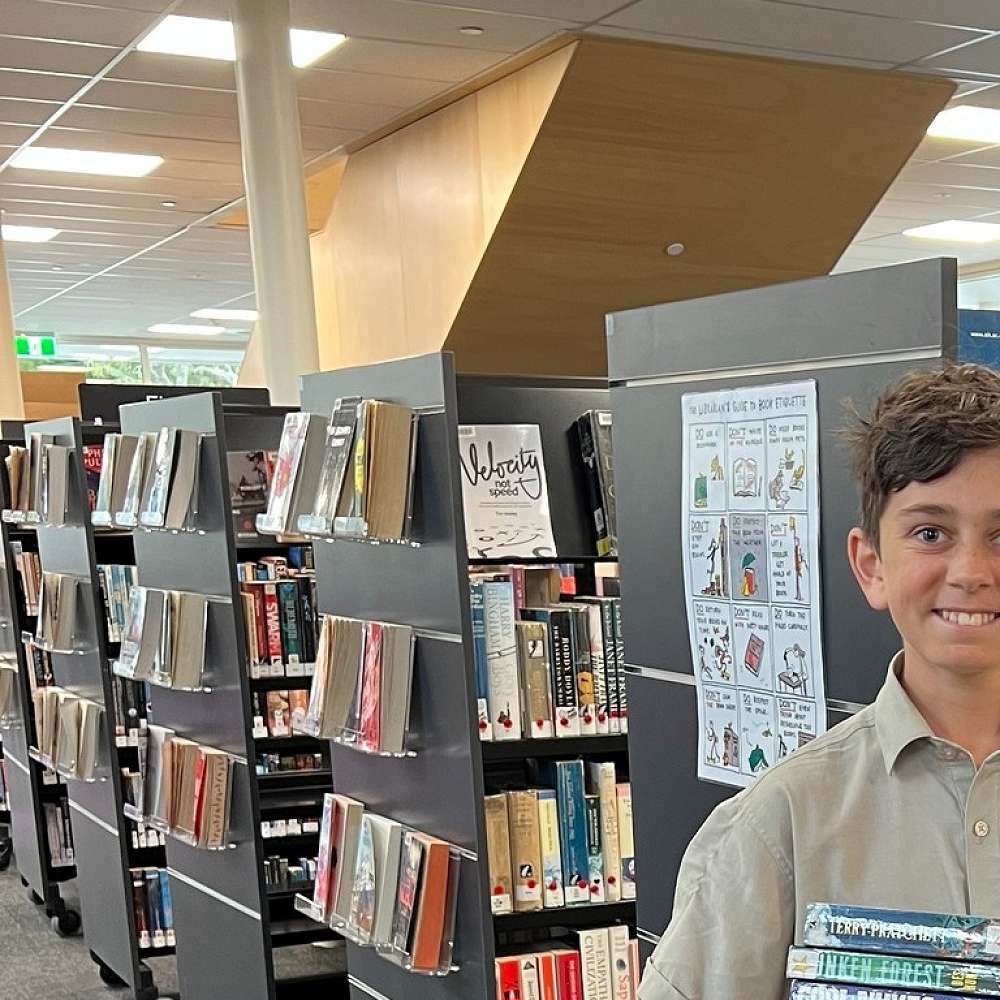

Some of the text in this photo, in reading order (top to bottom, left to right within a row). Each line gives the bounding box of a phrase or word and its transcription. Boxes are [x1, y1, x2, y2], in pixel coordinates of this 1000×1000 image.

[460, 441, 543, 500] Velocity
[495, 479, 511, 488] not
[489, 487, 519, 498] speed
[266, 602, 282, 655] SWARM
[487, 588, 500, 651] BINGHAM
[500, 597, 513, 641] HARRY
[561, 636, 571, 673] RODDY
[829, 917, 867, 936] TERRY
[882, 957, 945, 987] FOREST
